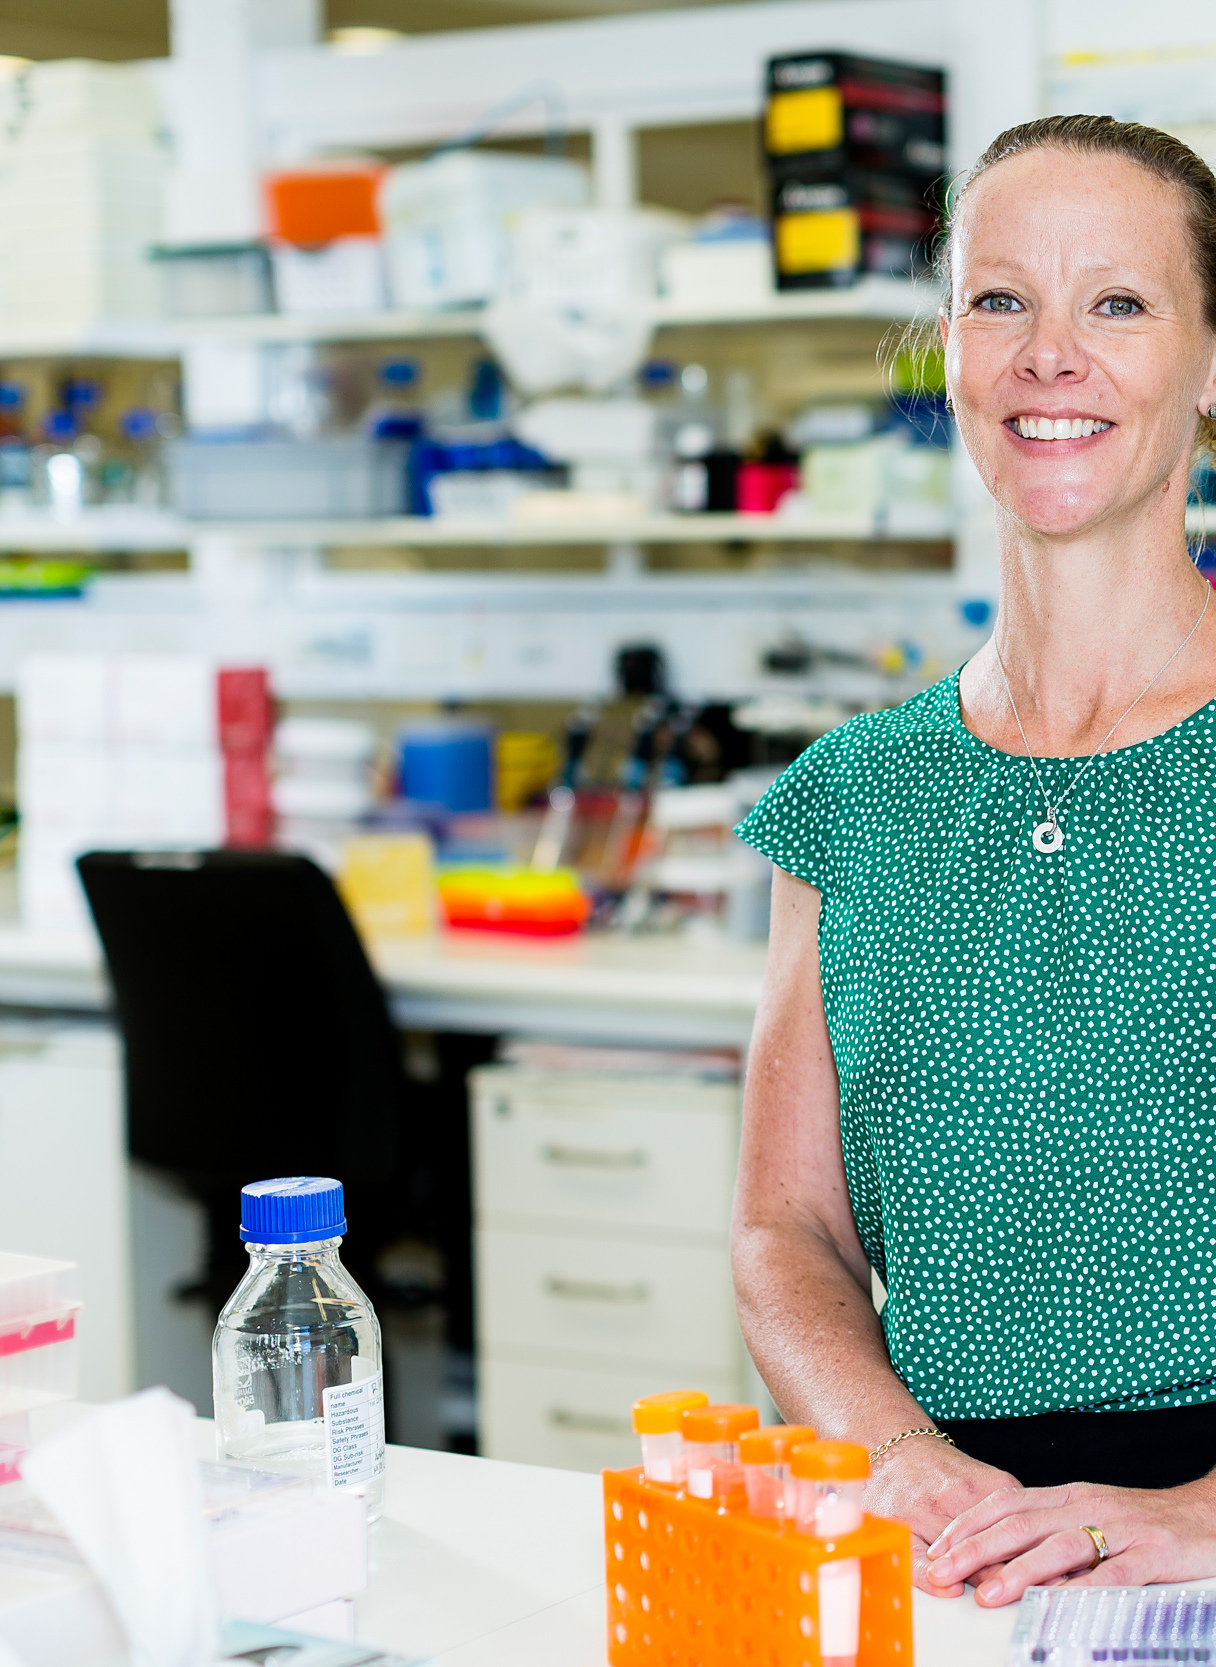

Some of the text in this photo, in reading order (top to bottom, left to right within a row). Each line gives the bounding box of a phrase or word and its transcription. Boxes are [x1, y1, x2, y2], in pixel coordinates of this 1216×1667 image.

[342, 1388, 363, 1398] chemical
[331, 1408, 359, 1418] Hazardous
[331, 1416, 359, 1427] Substance
[332, 1424, 365, 1436] Risk Phrases
[332, 1431, 369, 1445] Safety Phrases
[333, 1443, 357, 1454] DG Class
[333, 1455, 342, 1463] DG
[343, 1451, 364, 1460] Sub-risk
[334, 1468, 359, 1477] Researcher
[335, 1479, 347, 1487] Date
